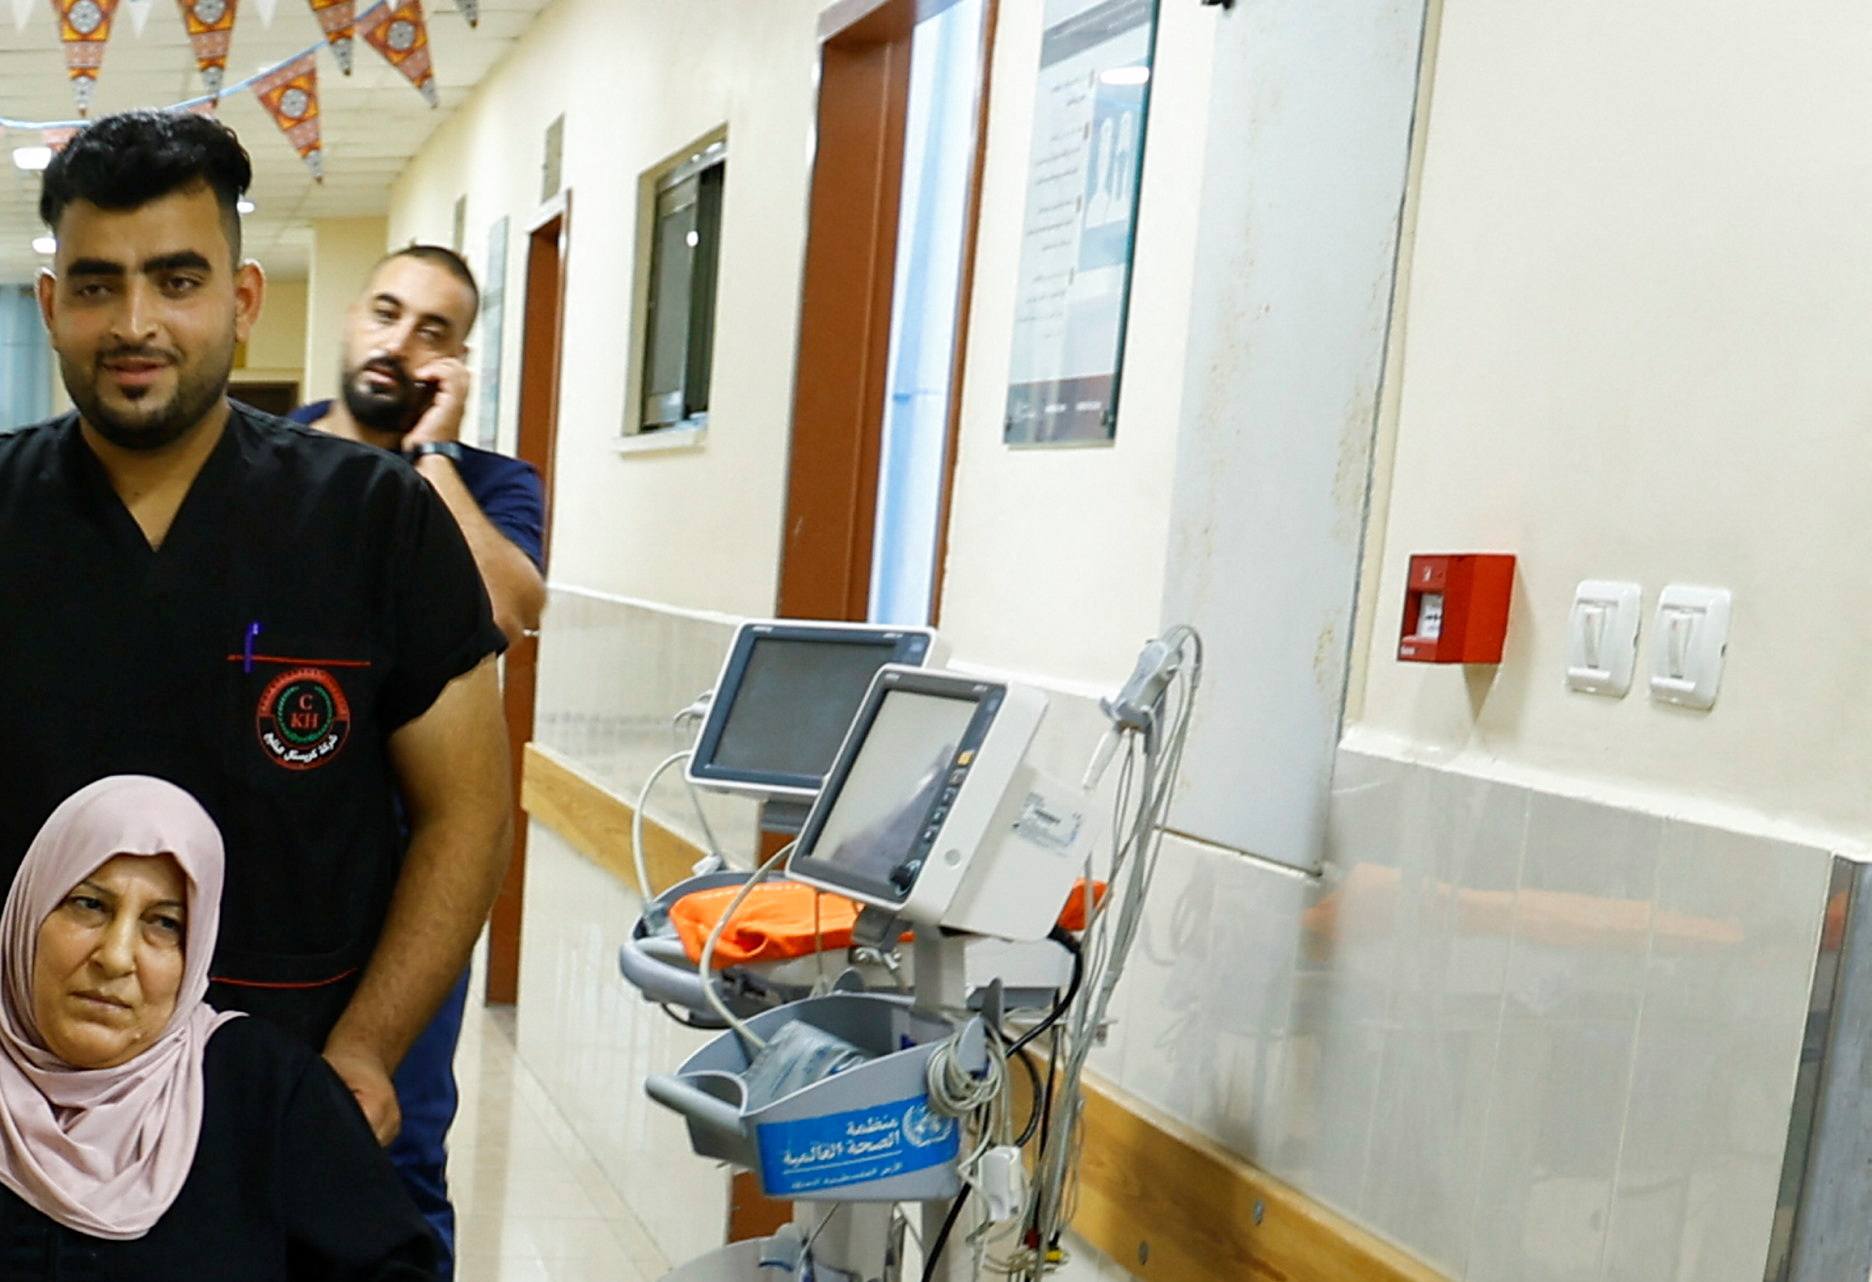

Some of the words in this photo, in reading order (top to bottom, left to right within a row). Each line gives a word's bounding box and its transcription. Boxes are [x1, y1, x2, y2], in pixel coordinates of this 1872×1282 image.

[299, 694, 313, 710] C
[291, 713, 319, 728] KH
[846, 1115, 899, 1136] منظمة
[846, 1130, 900, 1155] الصحة
[783, 1141, 843, 1167] العالمية
